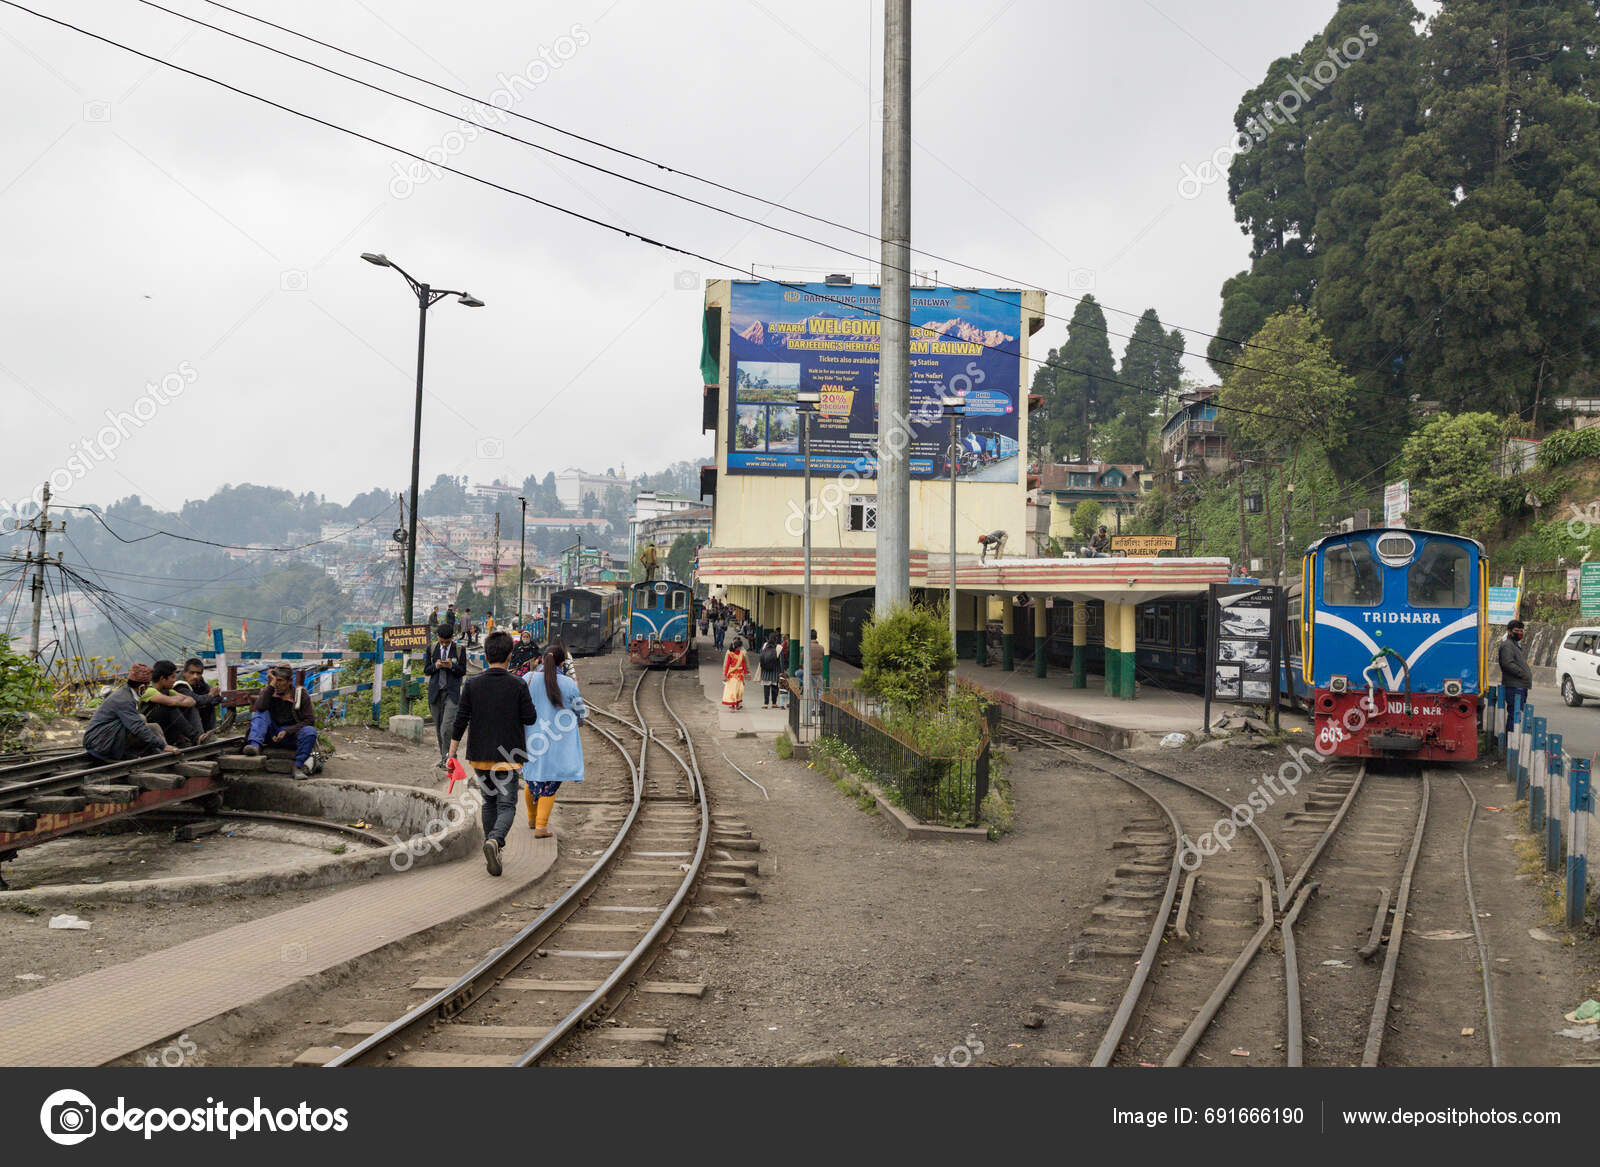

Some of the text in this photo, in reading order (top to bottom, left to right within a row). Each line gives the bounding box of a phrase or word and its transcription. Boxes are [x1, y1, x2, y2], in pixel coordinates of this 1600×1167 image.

[912, 298, 950, 307] RAILWAY
[768, 323, 776, 333] A
[778, 323, 806, 333] WARM
[788, 340, 843, 350] DARJEELING'S
[845, 342, 880, 352] HERITAG
[931, 343, 983, 355] RAILWAY
[818, 355, 839, 364] Tickets
[840, 356, 852, 364] also
[918, 358, 939, 367] Station
[820, 384, 845, 392] AVAIL
[822, 394, 847, 403] 20%
[1362, 611, 1442, 625] TRIDHARA
[389, 627, 426, 637] PLEASE USE
[390, 636, 427, 647] FOOTPATH
[1320, 727, 1344, 743] 603
